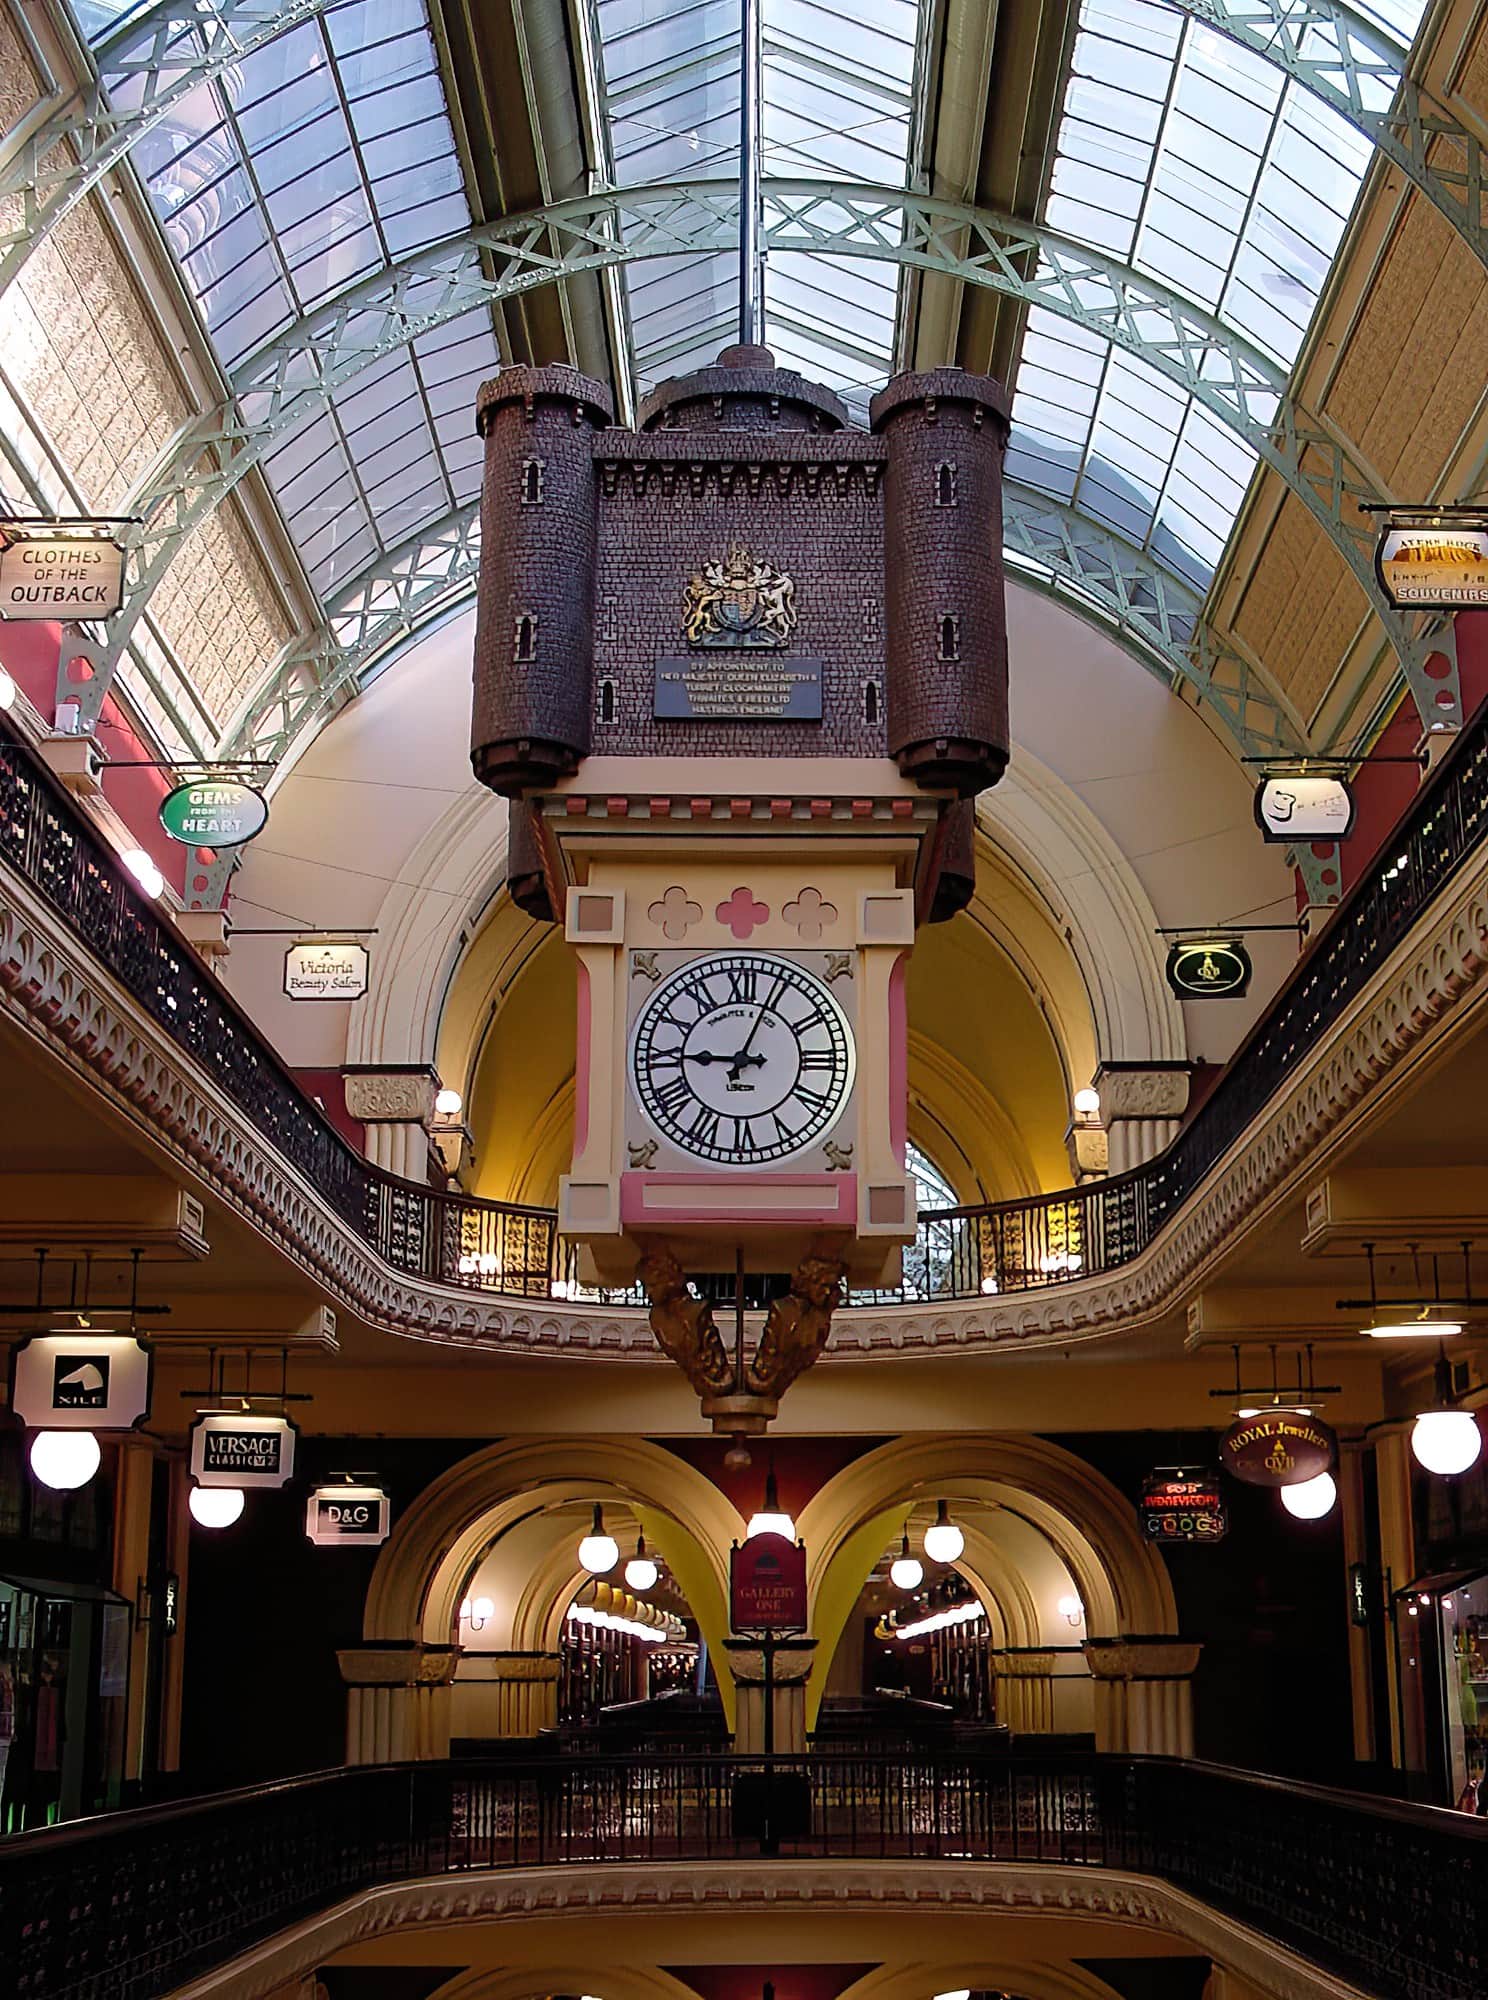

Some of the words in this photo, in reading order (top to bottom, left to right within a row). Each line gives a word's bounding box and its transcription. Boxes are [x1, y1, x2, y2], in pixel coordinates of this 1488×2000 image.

[22, 550, 102, 564] CLOTHES
[34, 569, 54, 580] OF
[60, 569, 88, 580] THE
[11, 586, 108, 602] OUTBACK
[1397, 588, 1488, 601] SOUVENIRS
[189, 790, 242, 804] GEMS
[182, 819, 241, 832] HEART
[300, 960, 354, 974] Victoria
[59, 1396, 102, 1404] XILE
[1229, 1423, 1275, 1452] ROYAL
[1276, 1421, 1329, 1449] Jewellers
[209, 1436, 278, 1455] VERSACE
[209, 1455, 253, 1466] CLASSIC
[328, 1506, 369, 1523] D&G
[740, 1586, 794, 1599] GALLERY
[756, 1600, 780, 1611] ONE
